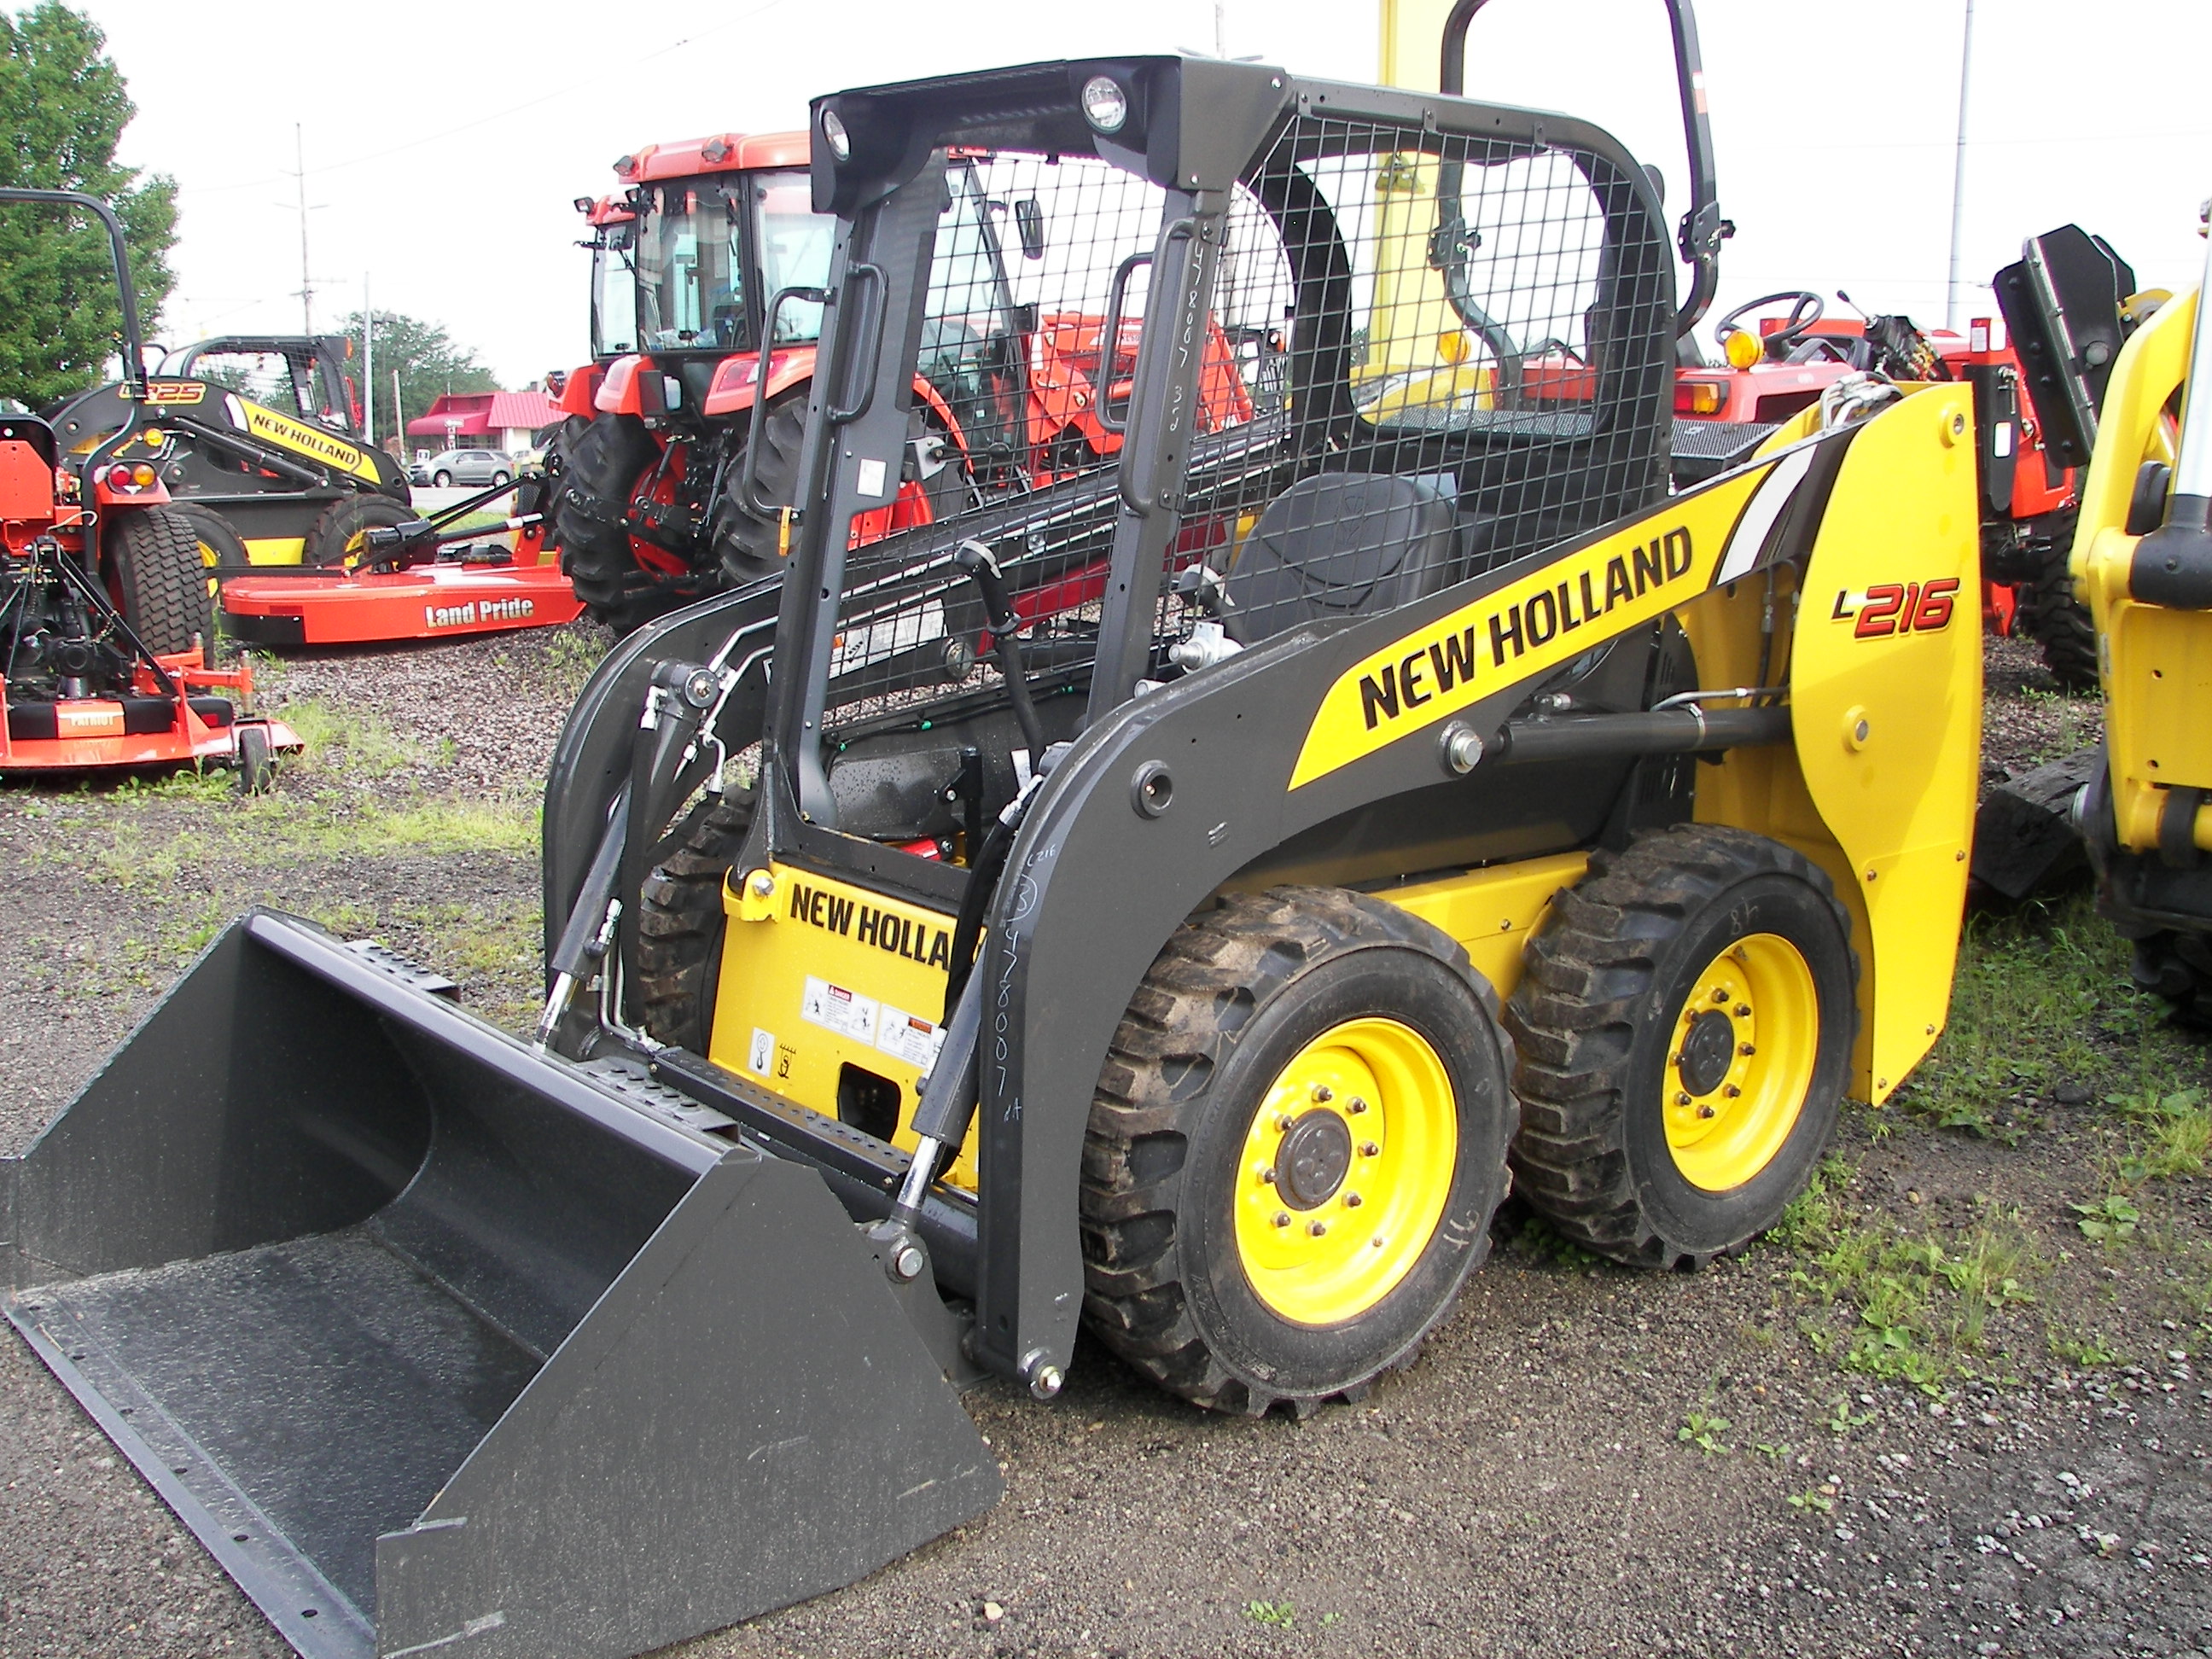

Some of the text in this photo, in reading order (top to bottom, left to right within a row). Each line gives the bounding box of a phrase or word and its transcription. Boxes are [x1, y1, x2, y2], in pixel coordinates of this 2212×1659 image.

[253, 414, 356, 465] NEW HOLLAND
[425, 597, 534, 629] Land Pride
[1359, 526, 1692, 731] NEW HOLLAND
[1831, 578, 1960, 639] L216
[790, 883, 952, 972] NEW HOLLA
